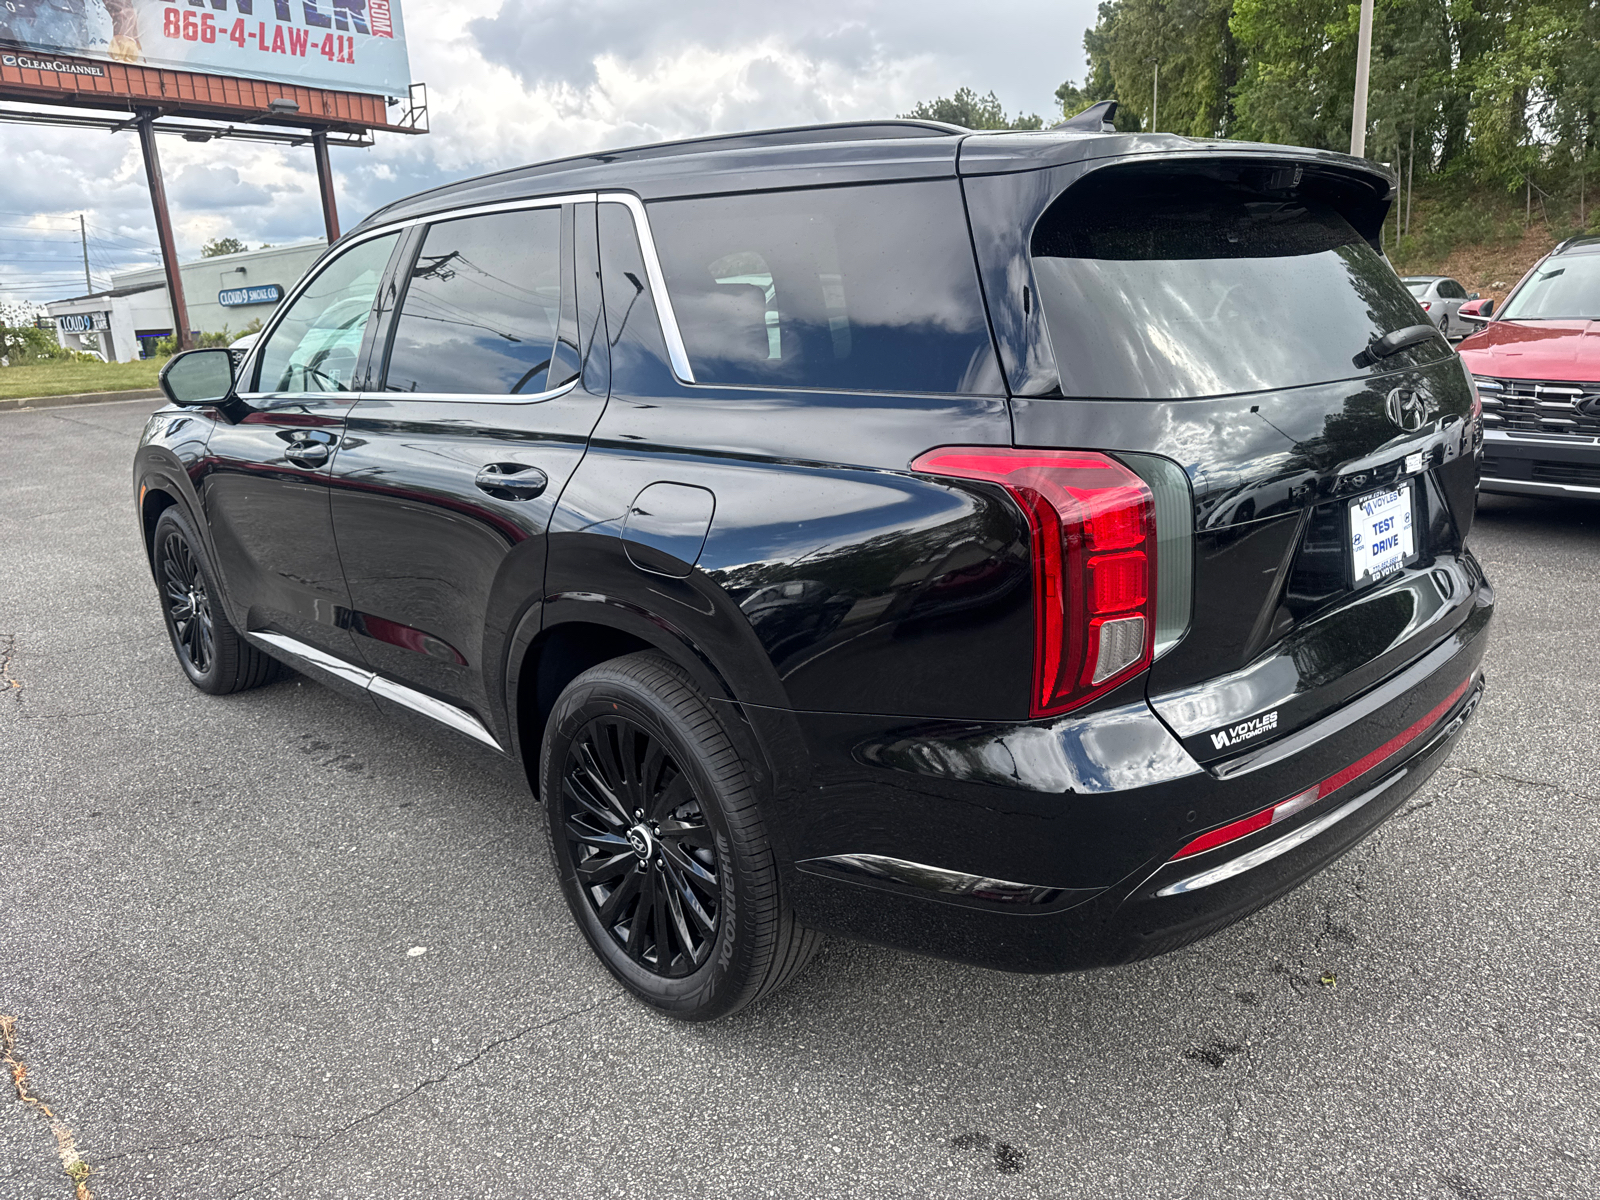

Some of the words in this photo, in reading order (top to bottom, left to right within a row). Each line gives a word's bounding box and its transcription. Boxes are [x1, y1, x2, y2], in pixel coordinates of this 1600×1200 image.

[164, 7, 355, 64] 866-4-LAW-411
[249, 289, 268, 301] SMOKE
[1372, 491, 1398, 508] VOYLES
[1372, 516, 1394, 536] TEST
[1372, 534, 1399, 556] DRIVE
[1380, 560, 1404, 577] VOYLES
[1229, 711, 1278, 738] VOYLES
[1231, 721, 1278, 745] AUTOMOTIVE
